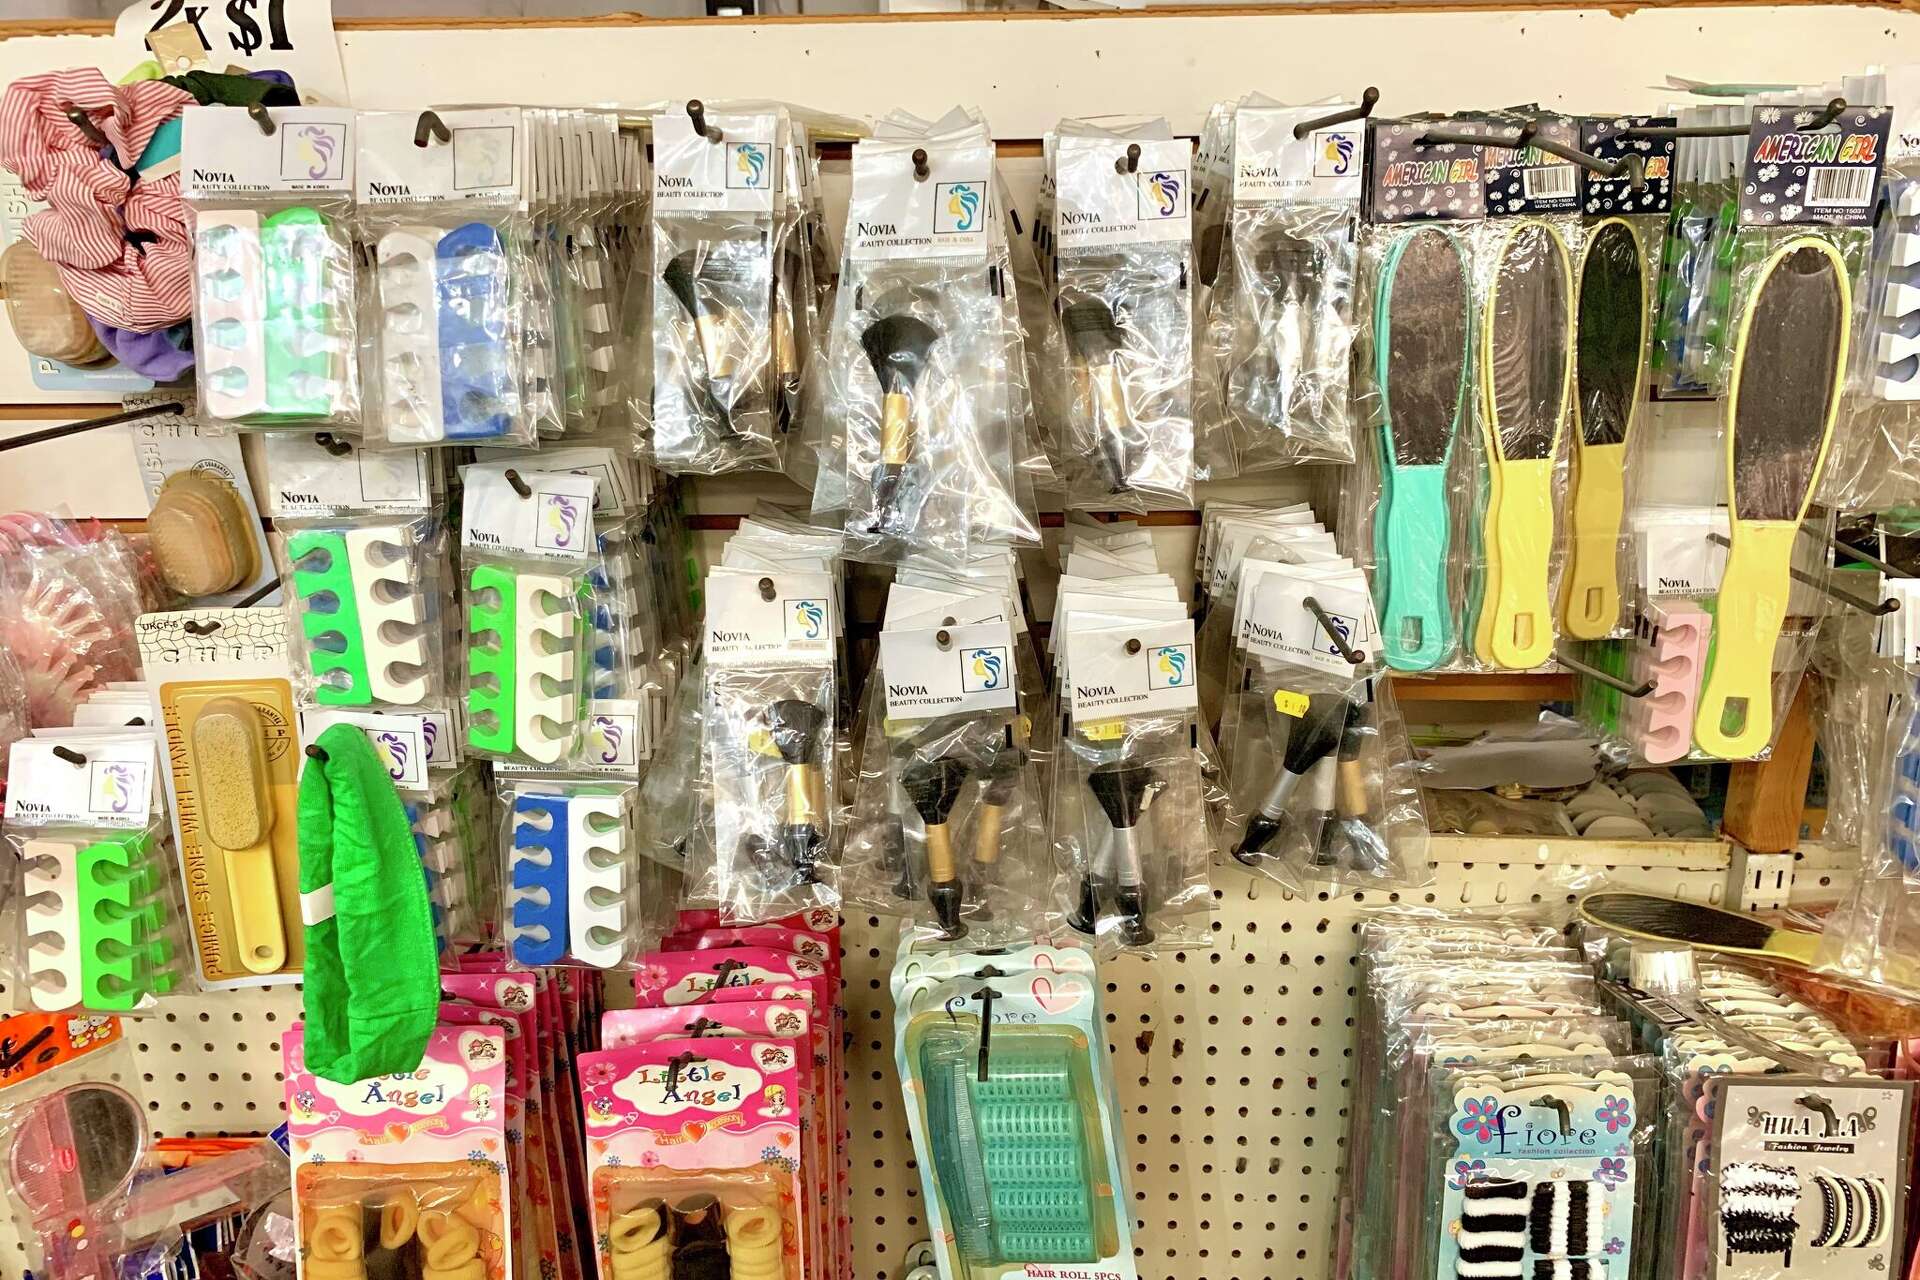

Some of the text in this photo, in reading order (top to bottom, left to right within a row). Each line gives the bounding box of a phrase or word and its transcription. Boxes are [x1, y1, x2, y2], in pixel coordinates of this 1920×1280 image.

[225, 0, 294, 56] $1
[1754, 133, 1841, 165] AMERICAN
[1838, 133, 1879, 164] GIRL
[1485, 145, 1541, 169] MERICAN
[1240, 166, 1279, 178] NOVIA
[1382, 157, 1479, 187] AMERICAN GIRL
[1645, 155, 1670, 179] GIRL
[192, 168, 235, 183] NOVIA
[658, 175, 693, 187] NOVIA
[369, 182, 411, 196] NOVIA
[683, 190, 725, 198] COLLECTION
[369, 197, 398, 205] BEAUTY
[1061, 211, 1101, 225] NOVIA
[858, 222, 896, 237] NOVIA
[1090, 224, 1137, 234] COLLECTION
[886, 237, 932, 247] COLLECTION
[281, 491, 319, 504] NOVIA
[470, 528, 501, 544] NOVIA
[469, 542, 490, 551] BEAUTY
[1658, 577, 1690, 588] NOVIA
[712, 631, 751, 642] NOVIA
[1252, 624, 1283, 641] NOVIA
[1250, 637, 1311, 656] BEAUTY COLLECTION
[889, 685, 928, 697] NOVIA
[1077, 686, 1116, 699] NOVIA
[889, 696, 963, 707] BEAUTY COLLECTION
[1077, 694, 1149, 709] BEAUTY COLLECTION
[15, 800, 51, 813] NOVIA
[176, 789, 200, 834] WITH
[186, 844, 210, 903] STONE
[686, 973, 765, 993] Litle
[361, 1082, 448, 1108] Angel
[659, 1083, 742, 1106] Angel
[1769, 1142, 1849, 1152] Fashion Jewelry
[1027, 1270, 1056, 1278] HAIR
[1059, 1271, 1091, 1280] ROLL
